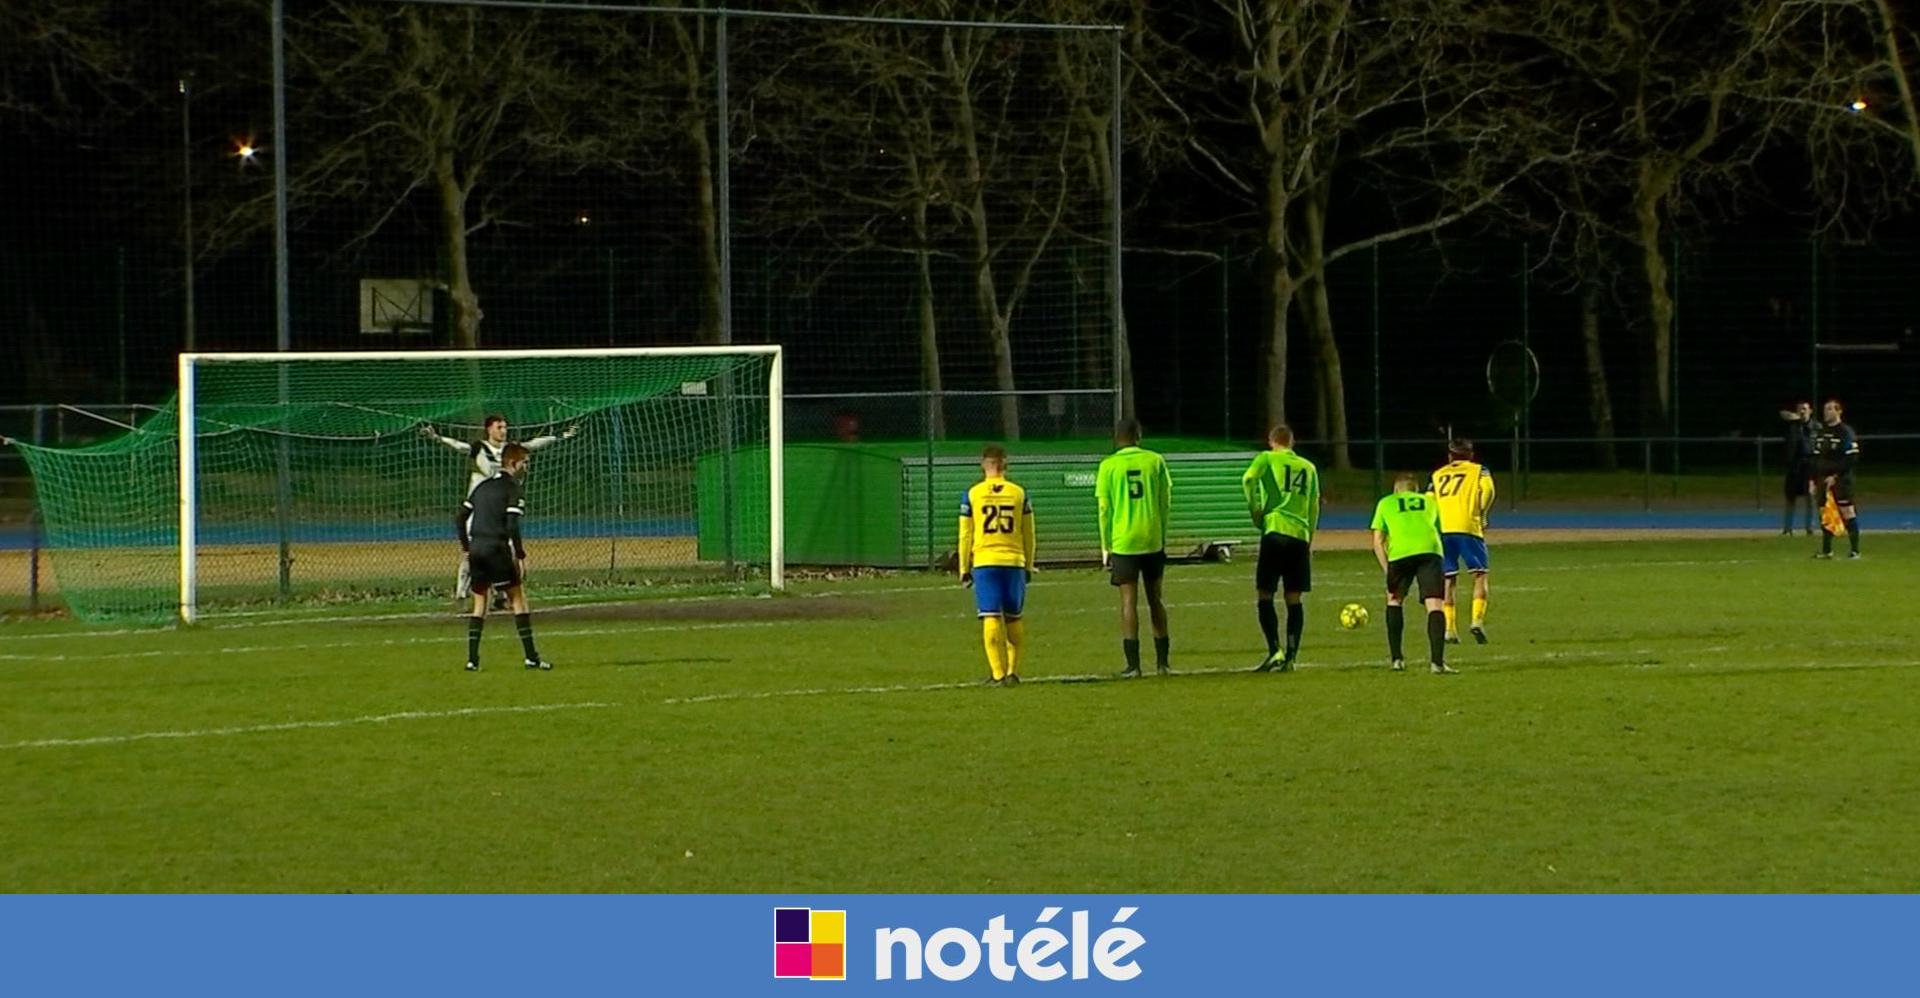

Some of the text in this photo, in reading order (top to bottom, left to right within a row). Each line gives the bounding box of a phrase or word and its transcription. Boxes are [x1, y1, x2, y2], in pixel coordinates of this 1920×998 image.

[1126, 469, 1143, 499] 5
[1283, 464, 1307, 495] 14
[1438, 474, 1466, 497] 27
[982, 505, 1015, 533] 25
